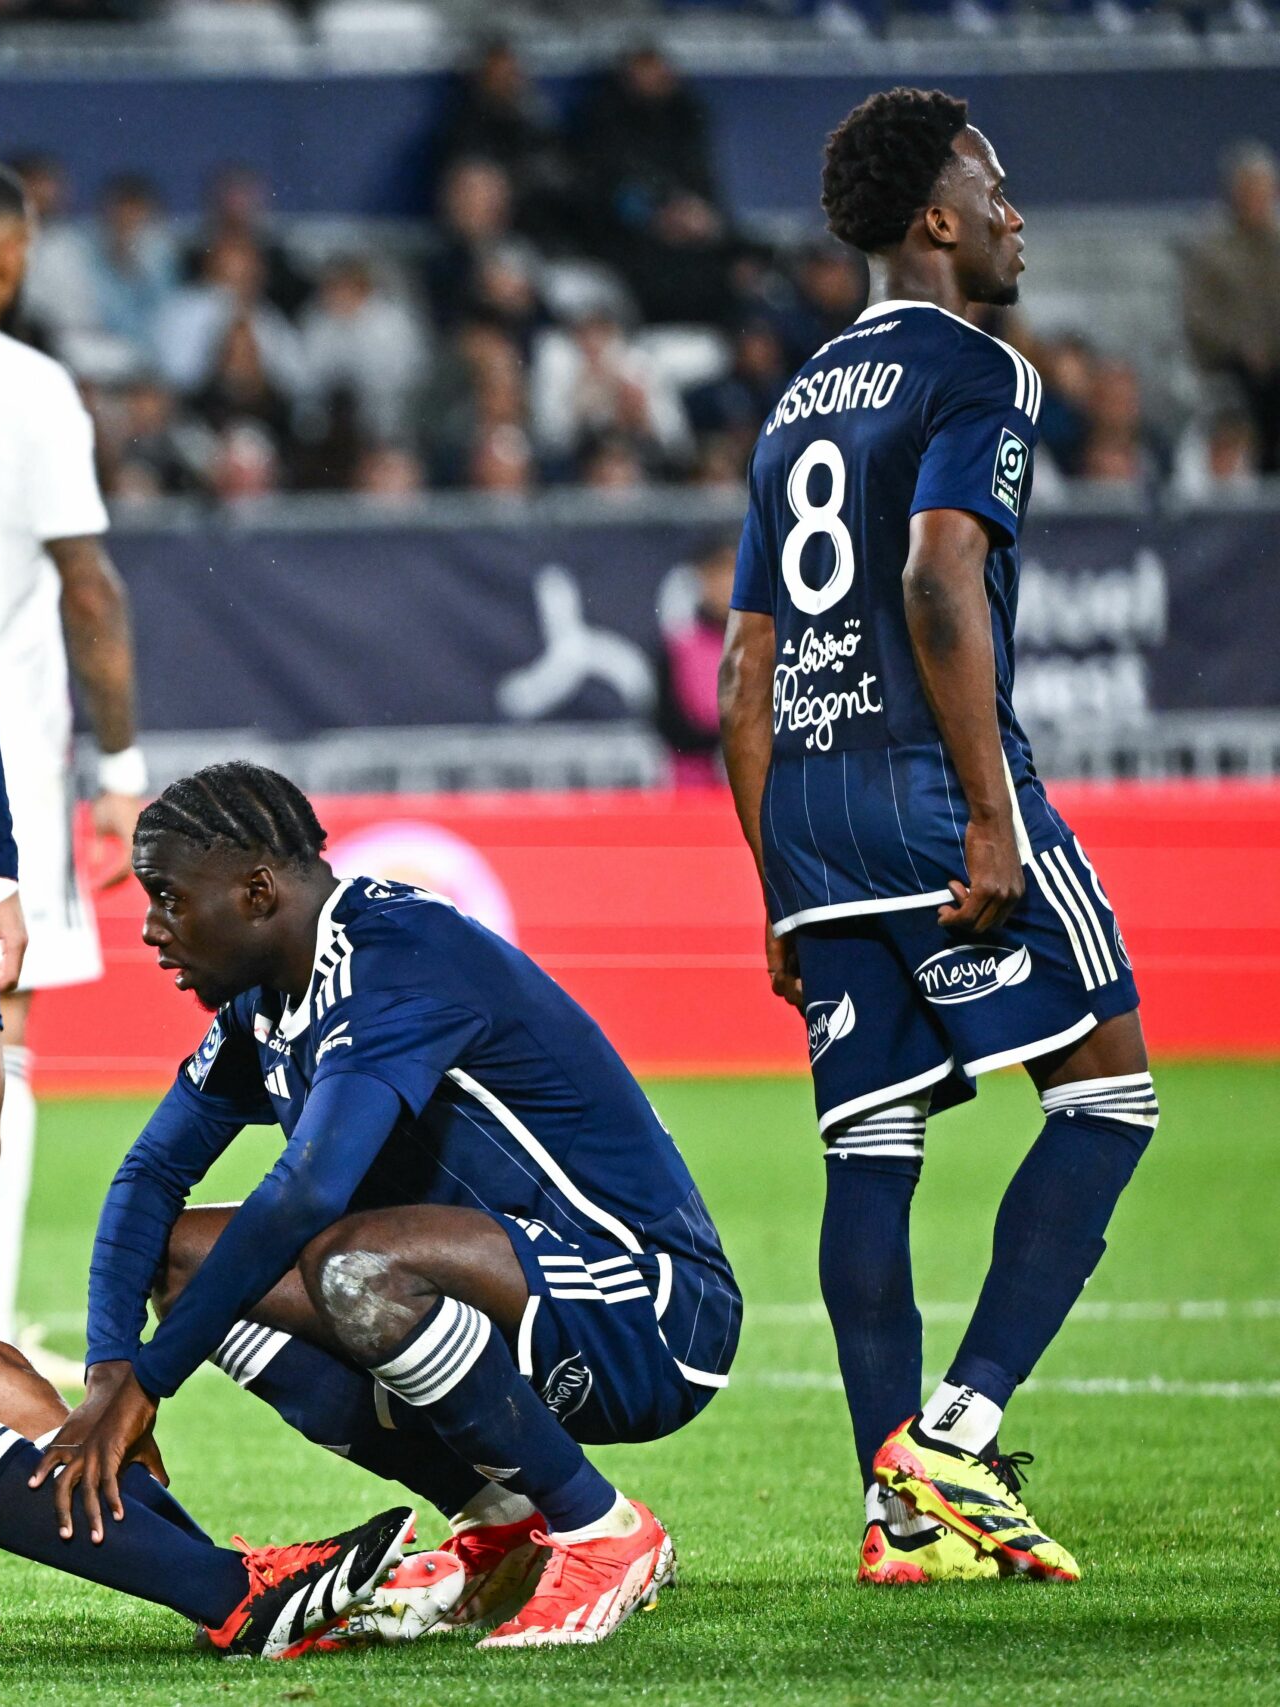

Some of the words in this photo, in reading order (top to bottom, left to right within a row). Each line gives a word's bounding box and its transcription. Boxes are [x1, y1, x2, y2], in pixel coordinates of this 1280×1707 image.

[782, 439, 855, 616] 8
[773, 663, 883, 752] Régent
[919, 956, 1001, 994] Meyva
[547, 1365, 589, 1414] Meyv
